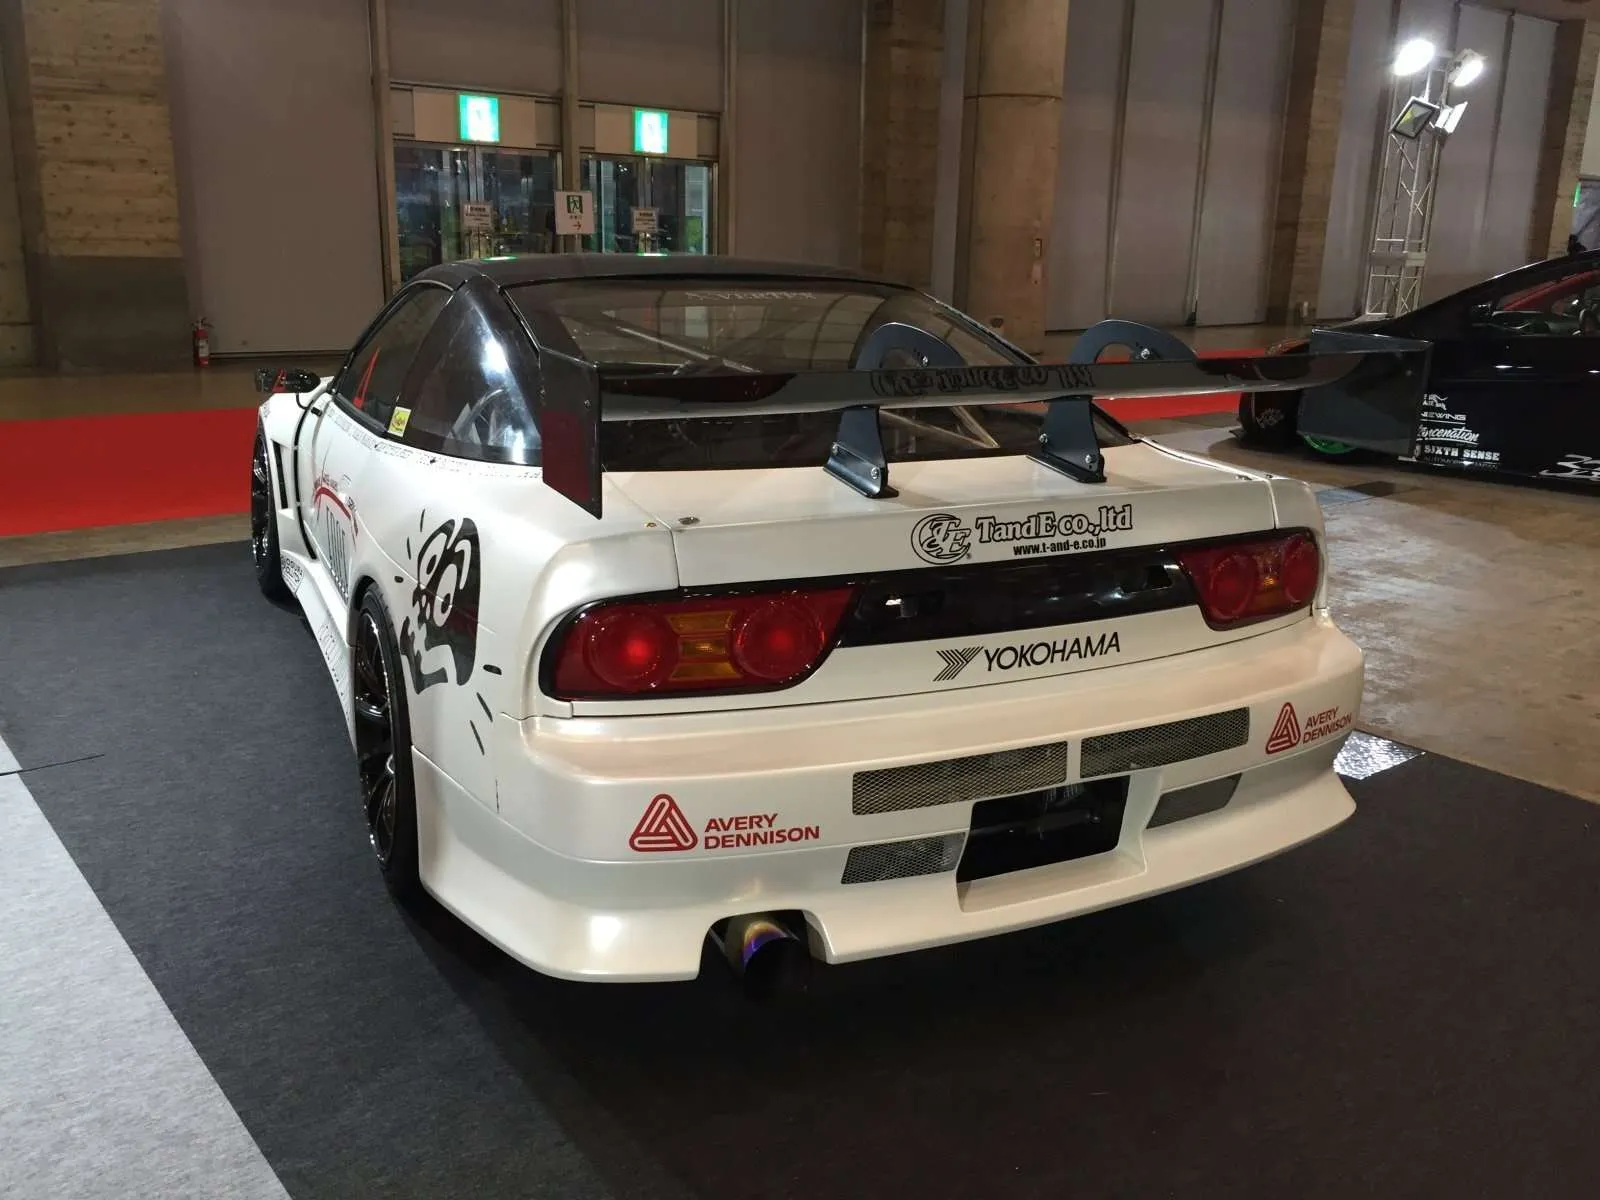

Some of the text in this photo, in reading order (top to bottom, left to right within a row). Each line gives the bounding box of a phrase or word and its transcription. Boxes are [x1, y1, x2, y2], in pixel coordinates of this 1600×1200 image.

[1424, 444, 1501, 461] SIXTH SENSE
[1013, 537, 1107, 556] www.t-and-e.co.jp
[984, 631, 1121, 672] YOKOHAMA
[1303, 712, 1352, 744] DENNISON
[1304, 706, 1340, 730] AVERY
[704, 813, 778, 833] AVERY
[704, 826, 820, 850] DENNISON
